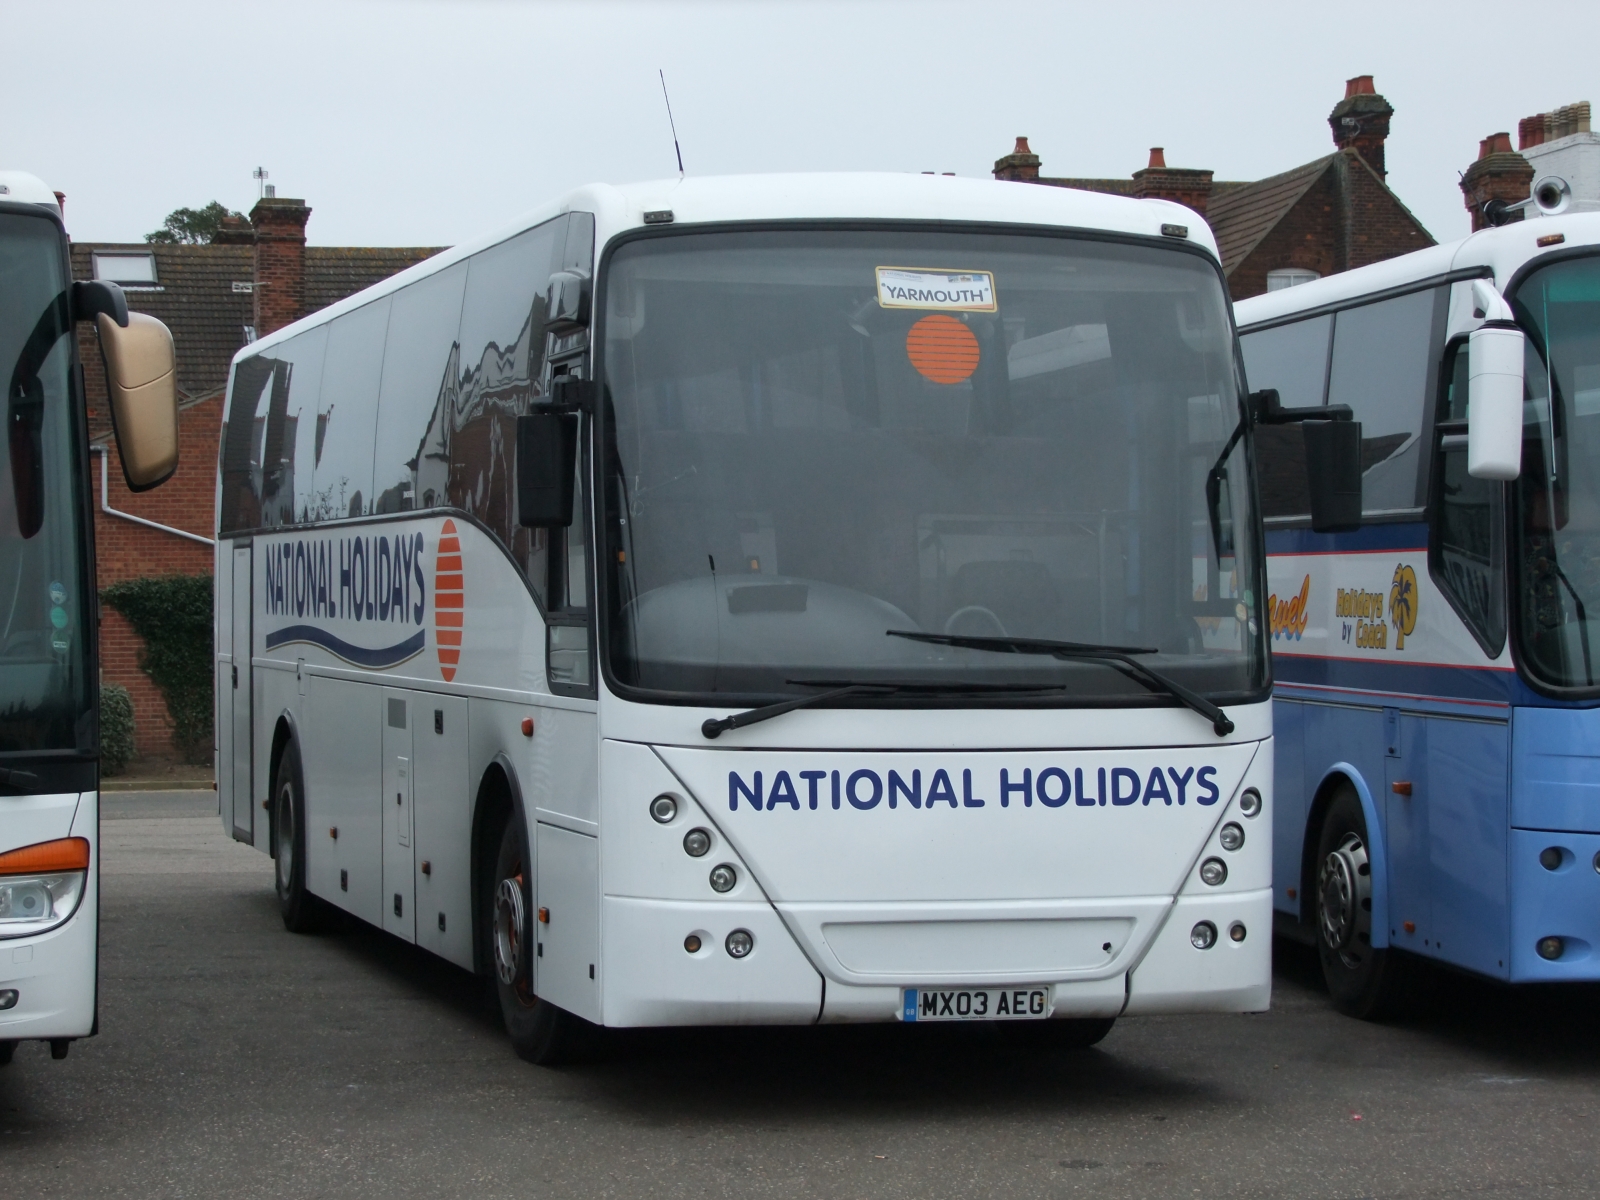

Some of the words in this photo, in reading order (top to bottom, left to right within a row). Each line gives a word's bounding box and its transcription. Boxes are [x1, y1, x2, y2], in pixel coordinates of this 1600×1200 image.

[887, 285, 984, 303] YARMOUTH
[265, 539, 336, 619] NATIONAL
[339, 531, 426, 626] HOLIDAYS
[1335, 588, 1384, 623] Holidays
[1341, 621, 1352, 644] by
[1355, 618, 1387, 650] Coach
[728, 768, 985, 812] NATIONAL
[1000, 765, 1220, 808] HOLIDAYS
[922, 991, 989, 1016] MX03
[996, 990, 1045, 1015] AEG
